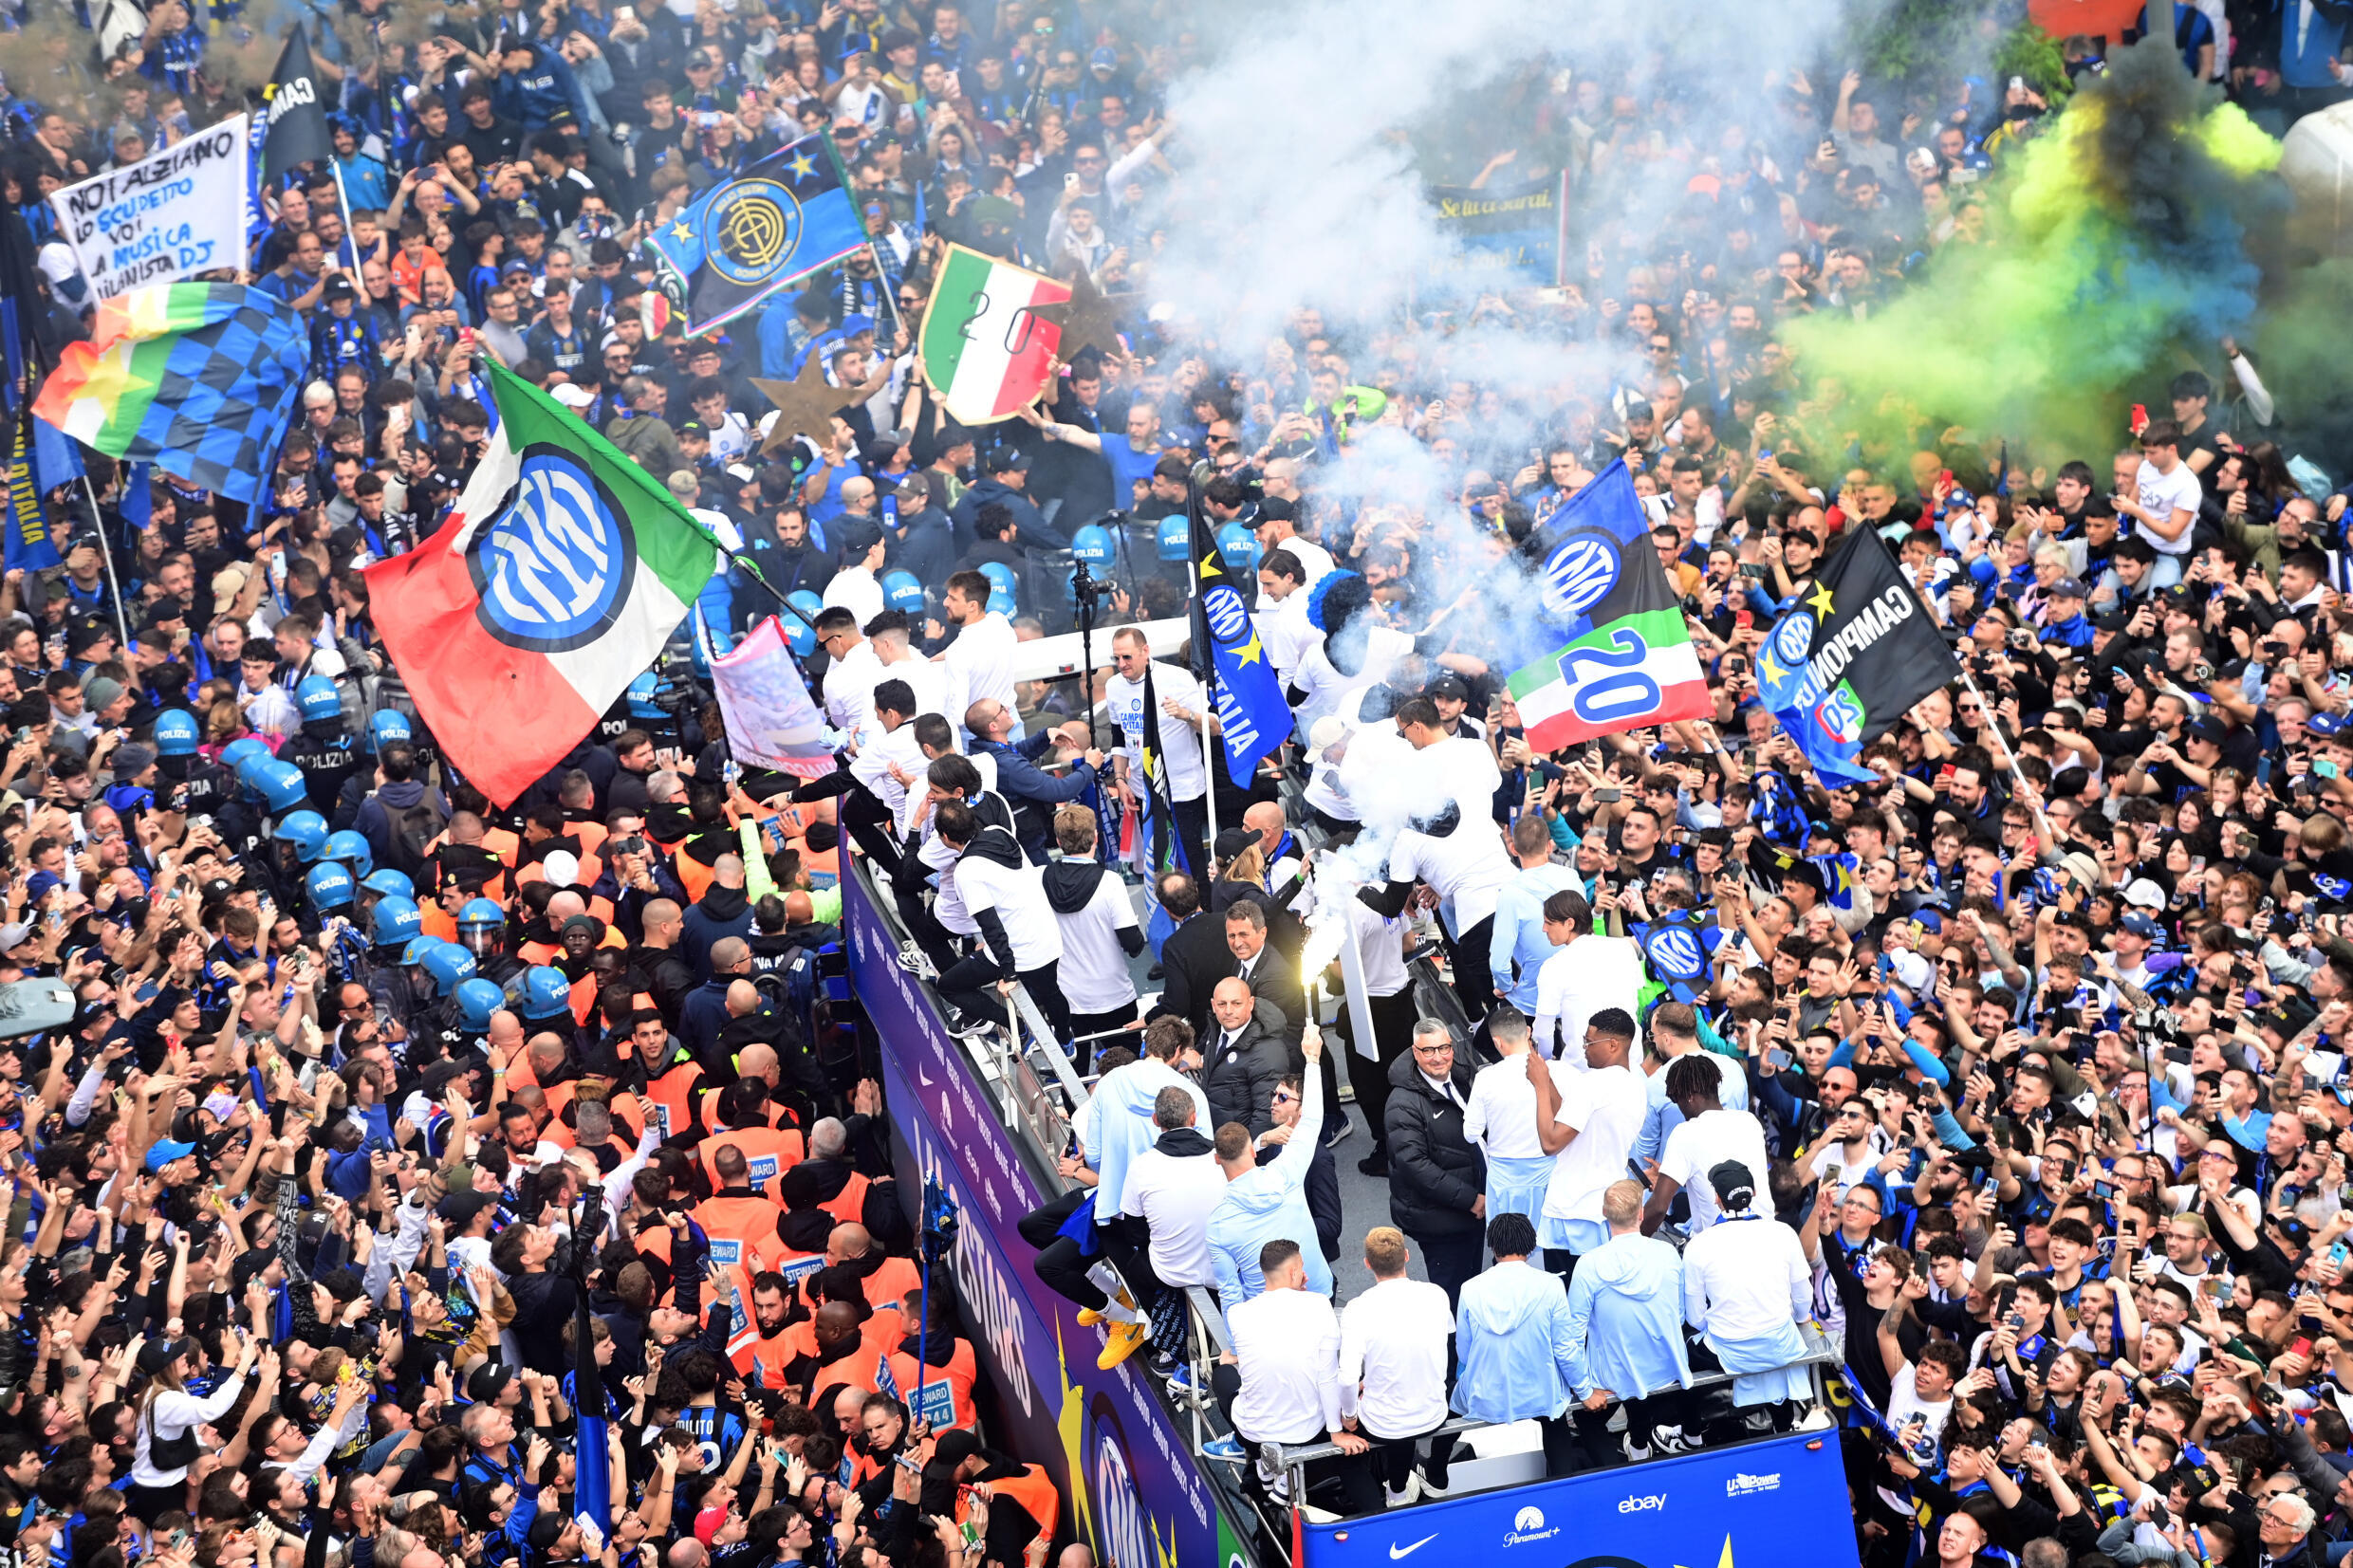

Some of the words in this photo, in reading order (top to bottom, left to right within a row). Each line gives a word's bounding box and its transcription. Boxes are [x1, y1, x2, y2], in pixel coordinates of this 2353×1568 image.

[69, 177, 116, 215] NOI
[97, 177, 194, 232] SCUDETTO
[178, 240, 215, 269] DJ
[9, 462, 46, 545] D'ITALIA
[1557, 626, 1663, 725] 20
[303, 691, 339, 707] POLIZIA
[157, 729, 192, 740] POLIZIA
[314, 876, 348, 894] POLIZIA
[1617, 1492, 1668, 1514] ebay
[1502, 1525, 1561, 1548] Paramount+
